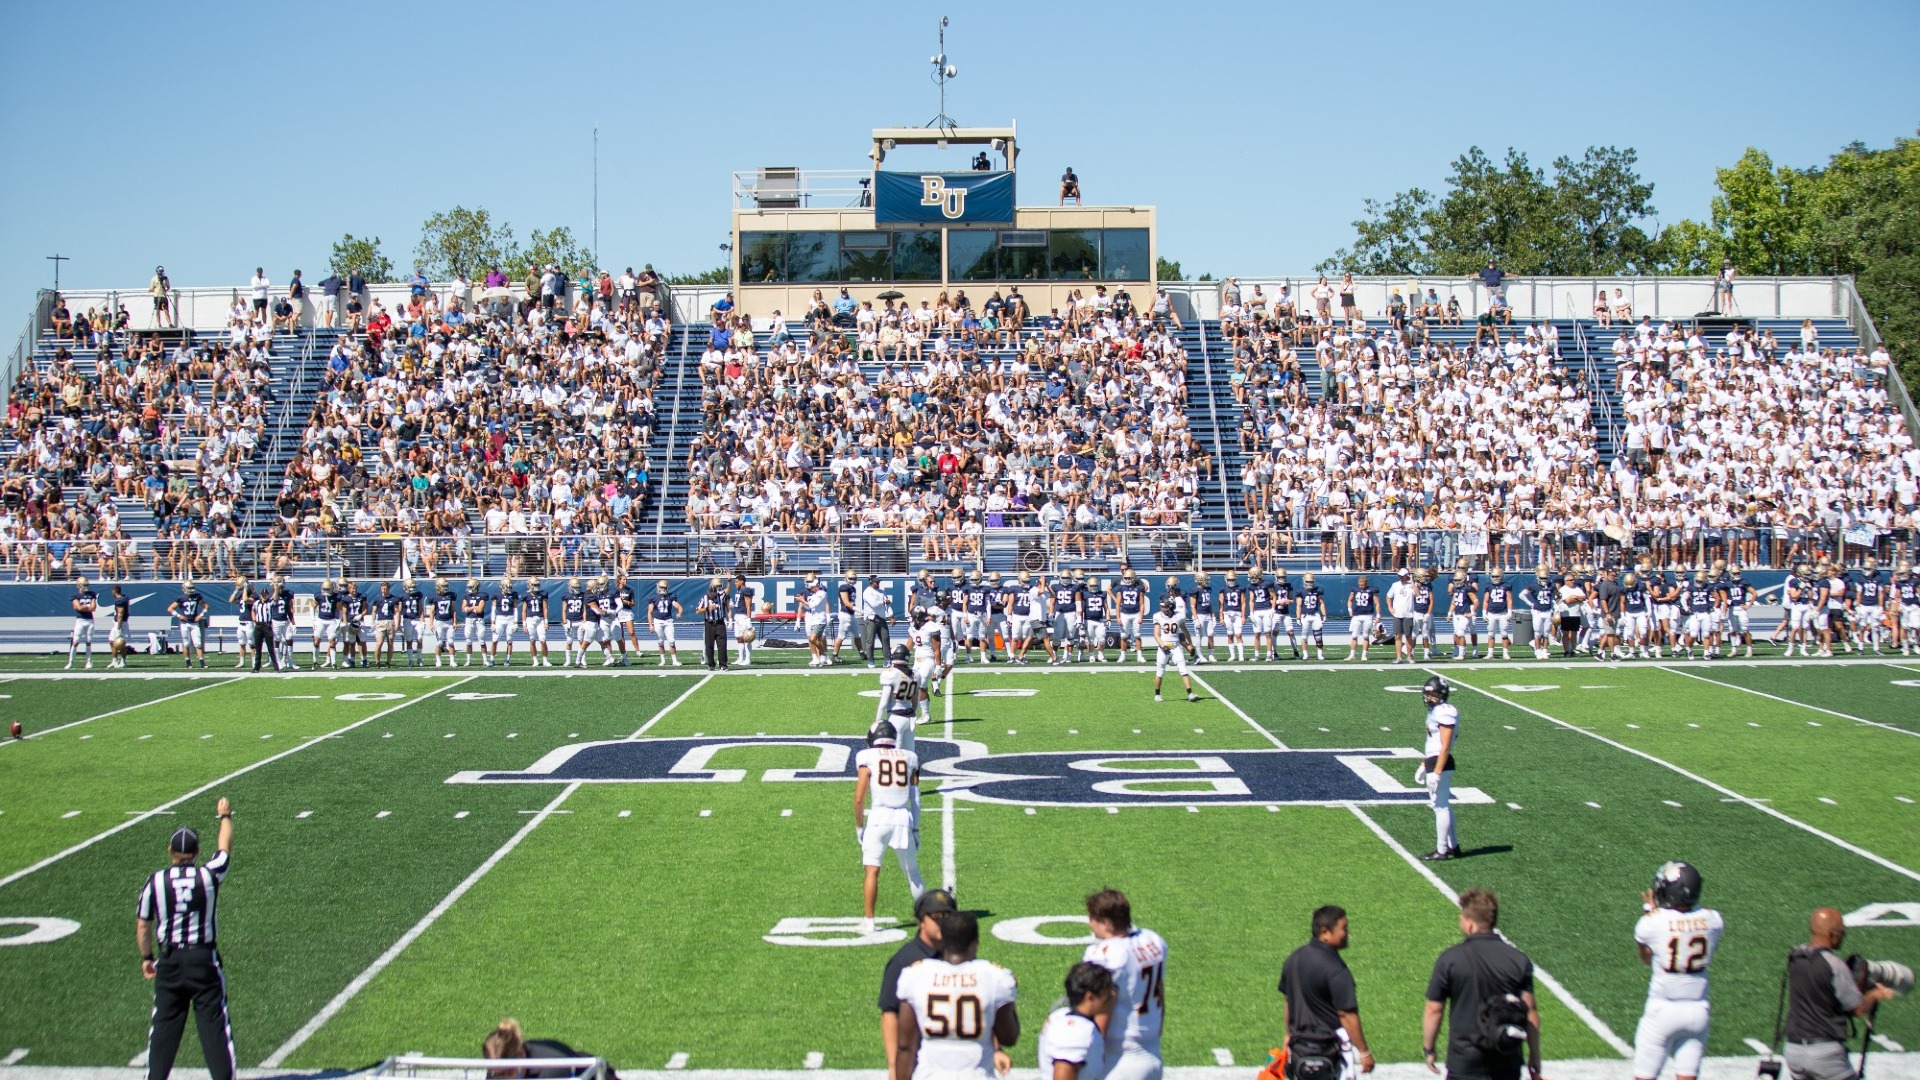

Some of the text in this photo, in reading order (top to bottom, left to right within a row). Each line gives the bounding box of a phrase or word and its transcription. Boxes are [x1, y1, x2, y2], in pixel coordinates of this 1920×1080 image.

[921, 176, 967, 220] BU
[1057, 591, 1072, 604] 95
[1122, 591, 1137, 605] 53
[1226, 591, 1239, 606] 13
[1254, 589, 1266, 603] 12
[1490, 589, 1505, 603] 42
[182, 602, 197, 615] 37
[381, 603, 389, 615] 4
[404, 600, 418, 613] 14
[437, 600, 451, 614] 57
[530, 600, 540, 612] 11
[657, 600, 669, 613] 41
[1088, 597, 1103, 611] 52
[1162, 622, 1178, 635] 30
[894, 680, 918, 701] 20
[878, 758, 908, 787] 89
[1669, 918, 1708, 932] LUTES
[1664, 935, 1708, 973] 12
[933, 972, 977, 988] LUTES
[924, 993, 983, 1040] 50
